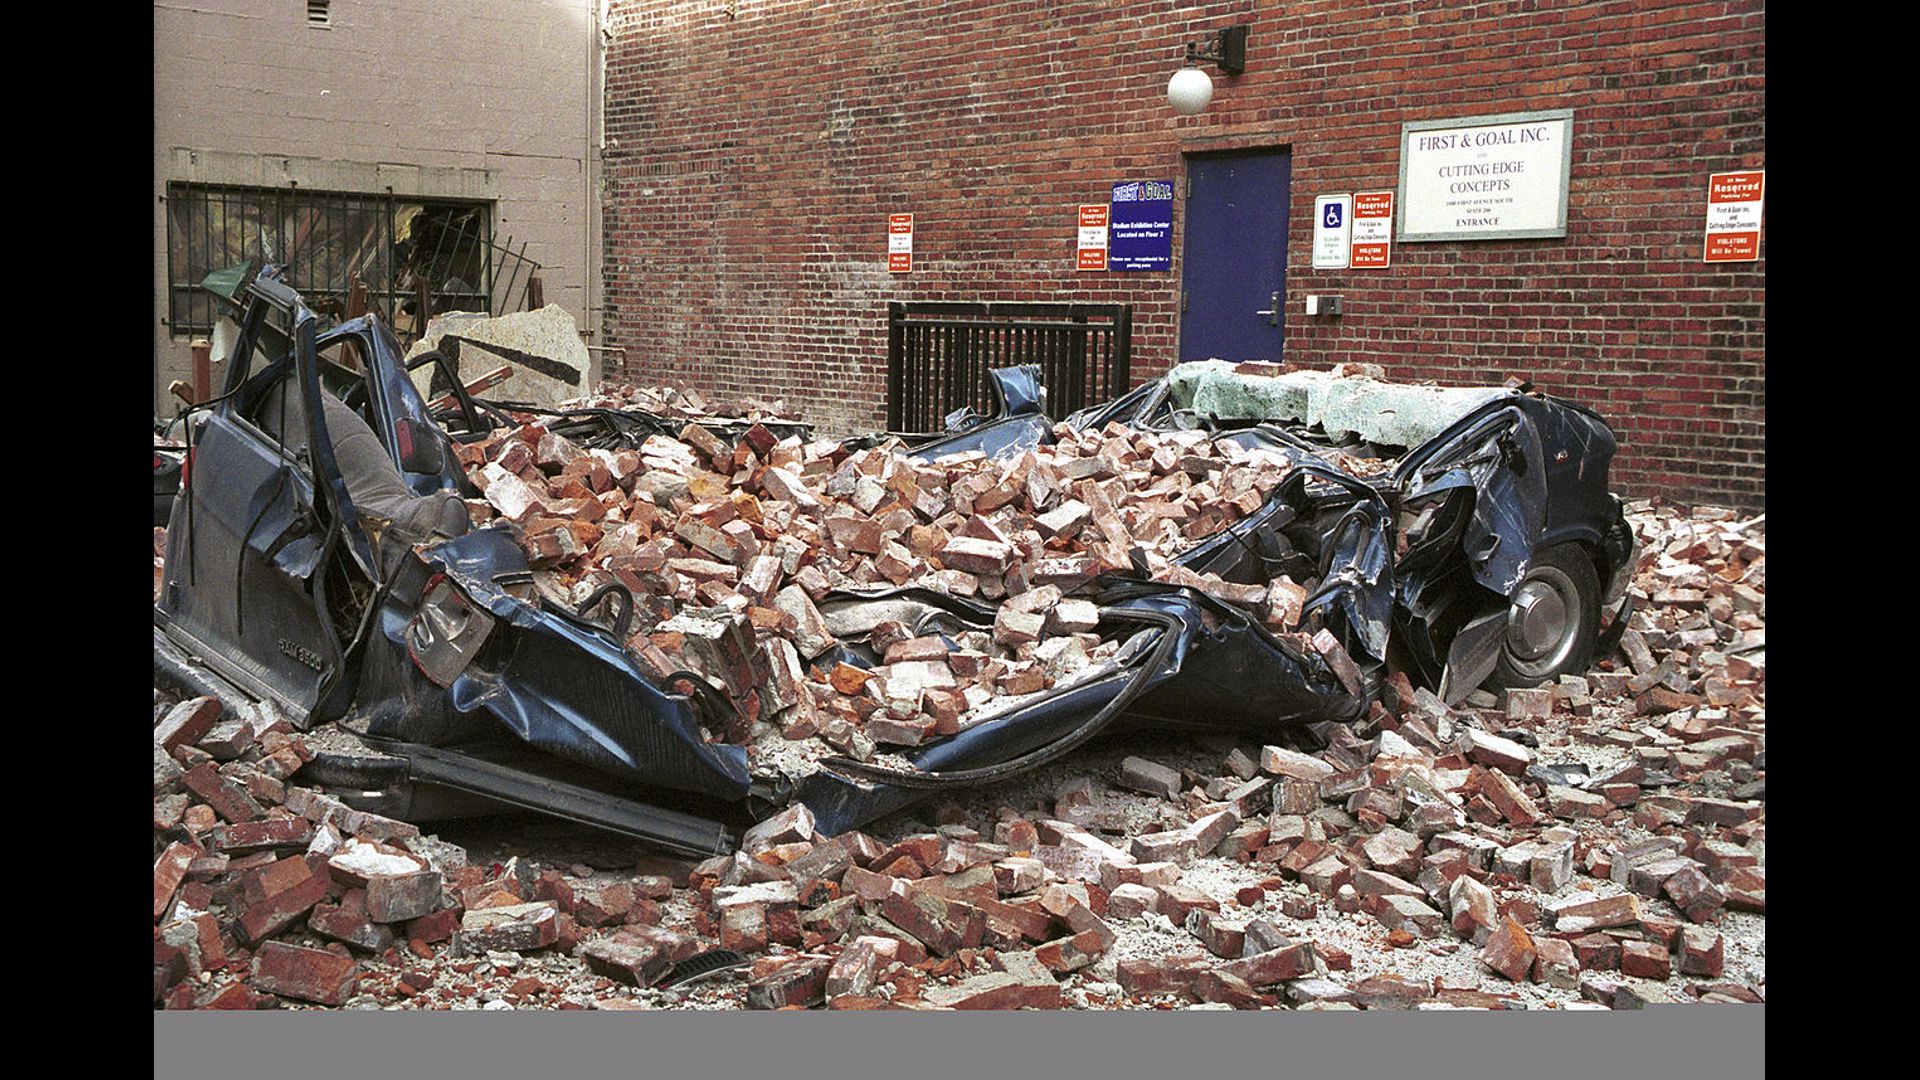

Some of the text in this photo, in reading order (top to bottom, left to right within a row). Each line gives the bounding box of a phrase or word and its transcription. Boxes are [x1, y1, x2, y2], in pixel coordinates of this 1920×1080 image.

[1419, 127, 1550, 151] FIRST & GOAL INC.
[1439, 160, 1525, 178] CUTTING EDGE
[1112, 181, 1172, 202] FIRST & GOAL
[1450, 179, 1510, 194] CONCEPTS
[1714, 182, 1760, 193] Reserved
[1356, 201, 1389, 210] Reserved
[1456, 217, 1500, 227] ENTRANCE
